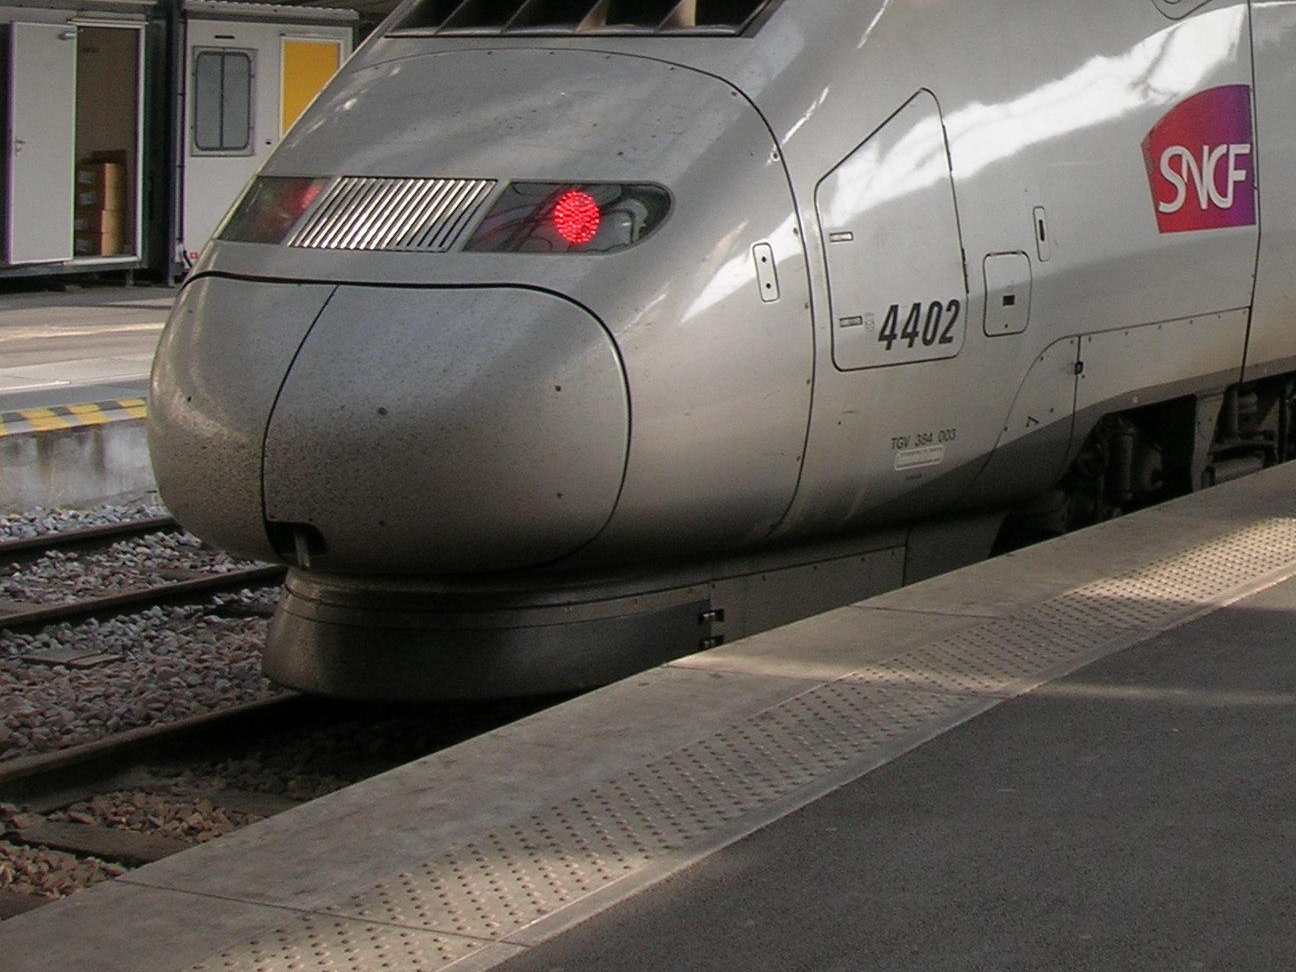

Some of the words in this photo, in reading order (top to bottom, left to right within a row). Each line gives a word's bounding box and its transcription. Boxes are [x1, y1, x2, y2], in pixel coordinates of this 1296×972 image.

[1157, 143, 1251, 214] SNCF
[878, 299, 960, 351] 4402
[891, 436, 911, 451] TGV
